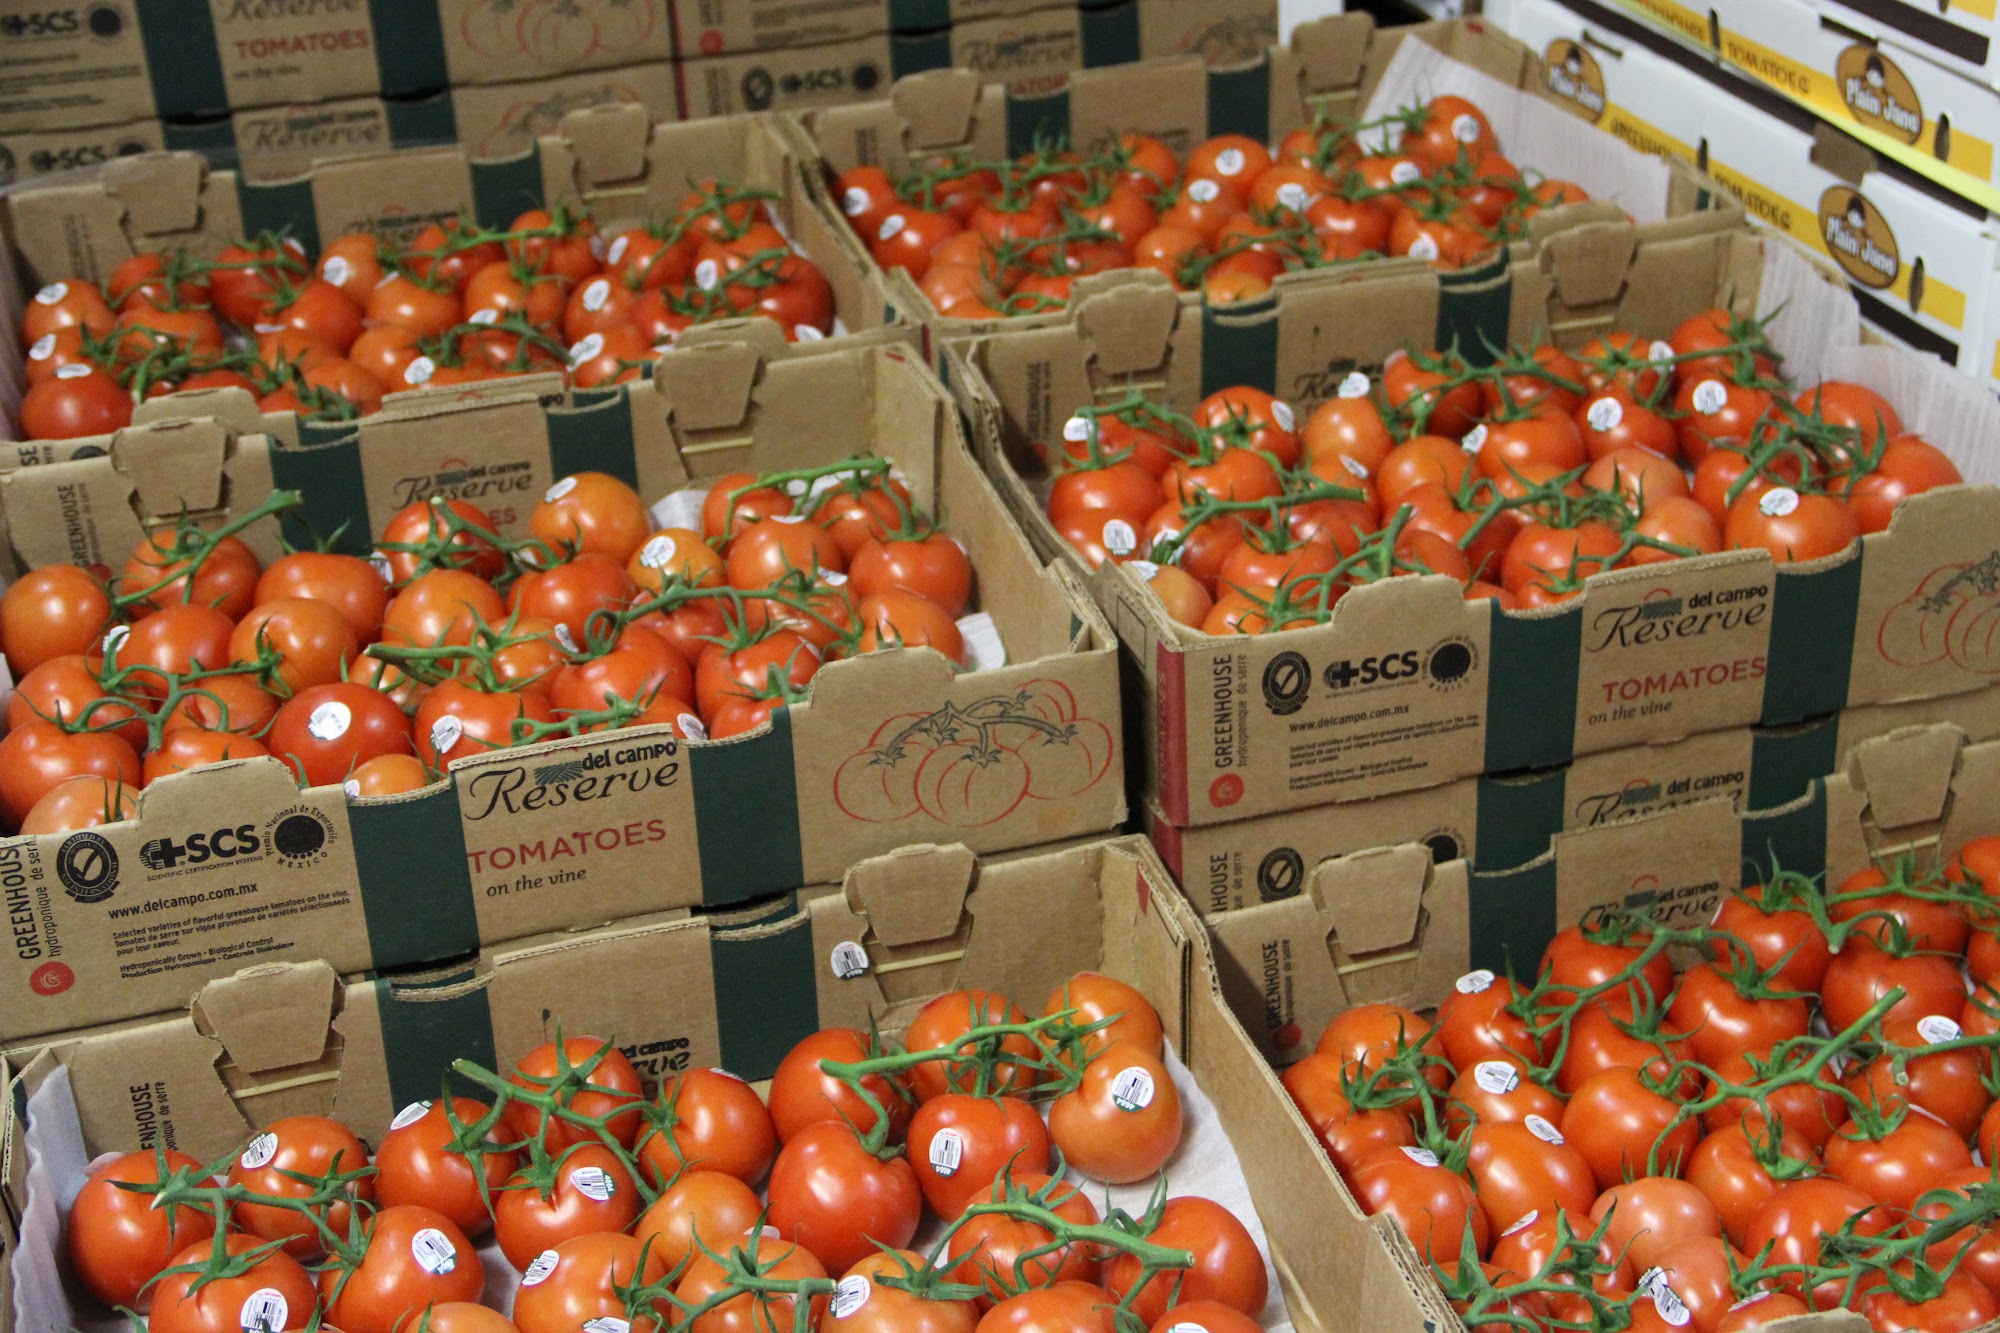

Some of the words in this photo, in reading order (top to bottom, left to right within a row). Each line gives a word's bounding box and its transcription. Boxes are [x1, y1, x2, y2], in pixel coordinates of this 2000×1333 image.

[29, 10, 78, 34] SCS
[234, 29, 370, 60] TOMATOES
[1846, 77, 1881, 116] Plain
[1882, 96, 1920, 134] Jane
[1826, 216, 1859, 257] Plain
[1861, 239, 1896, 278] Jane
[1688, 591, 1713, 609] del
[1716, 584, 1769, 605] campo
[1584, 602, 1767, 654] Reserve
[1360, 650, 1419, 684] SCS
[1601, 656, 1767, 703] TOMATOES
[1213, 654, 1233, 768] GREENHOUSE
[1289, 704, 1410, 734] www.delcampo.com.mx
[1588, 712, 1607, 725] on
[1612, 705, 1636, 720] the
[1640, 700, 1673, 716] vine
[582, 749, 611, 771] del
[615, 741, 677, 765] campo
[464, 762, 679, 821] Reserve
[1667, 777, 1690, 796] del
[1693, 771, 1744, 791] campo
[265, 804, 298, 829] Nacional
[300, 804, 309, 814] de
[310, 807, 338, 844] Exportación
[185, 824, 260, 863] SCS
[261, 830, 274, 857] Premio
[466, 818, 667, 874] TOMATOES
[29, 867, 44, 881] de
[147, 869, 183, 882] SCIENTIFIC
[184, 861, 234, 875] CERTIFICATION
[235, 855, 264, 866] SYSTEMS
[277, 851, 329, 869] MEXICO
[486, 882, 510, 897] on
[515, 873, 544, 892] the
[547, 868, 587, 885] vine
[1676, 882, 1719, 899] campo
[0, 846, 42, 960] GREENHOUS
[108, 882, 259, 920] www.delcampo.com.mx
[112, 927, 146, 940] Selected
[147, 921, 181, 933] varieties
[182, 918, 191, 926] of
[192, 912, 224, 925] flavorful
[225, 905, 269, 920] greenhouse
[270, 898, 306, 910] tomatoes
[317, 891, 330, 901] the
[331, 889, 350, 898] vine.
[36, 886, 62, 958] hydroponique
[114, 936, 146, 948] Tomates
[148, 933, 158, 941] de
[159, 930, 180, 939] serre
[181, 927, 194, 936] sur
[195, 923, 216, 933] vigne
[218, 915, 256, 928] provenant
[256, 913, 266, 921] de
[267, 907, 299, 919] variétés
[116, 948, 134, 957] pour
[135, 943, 151, 952] leur
[153, 938, 180, 948] saveur.
[120, 955, 176, 972] Hydroponically
[177, 951, 202, 961] Grown
[208, 942, 245, 956] Biological
[246, 936, 274, 949] Control
[121, 967, 163, 979] Production
[1262, 939, 1283, 1030] GREENHOUSE
[638, 1037, 690, 1056] campo
[154, 1081, 168, 1104] serre
[130, 1082, 158, 1151] ENHOUSE
[158, 1105, 170, 1116] de
